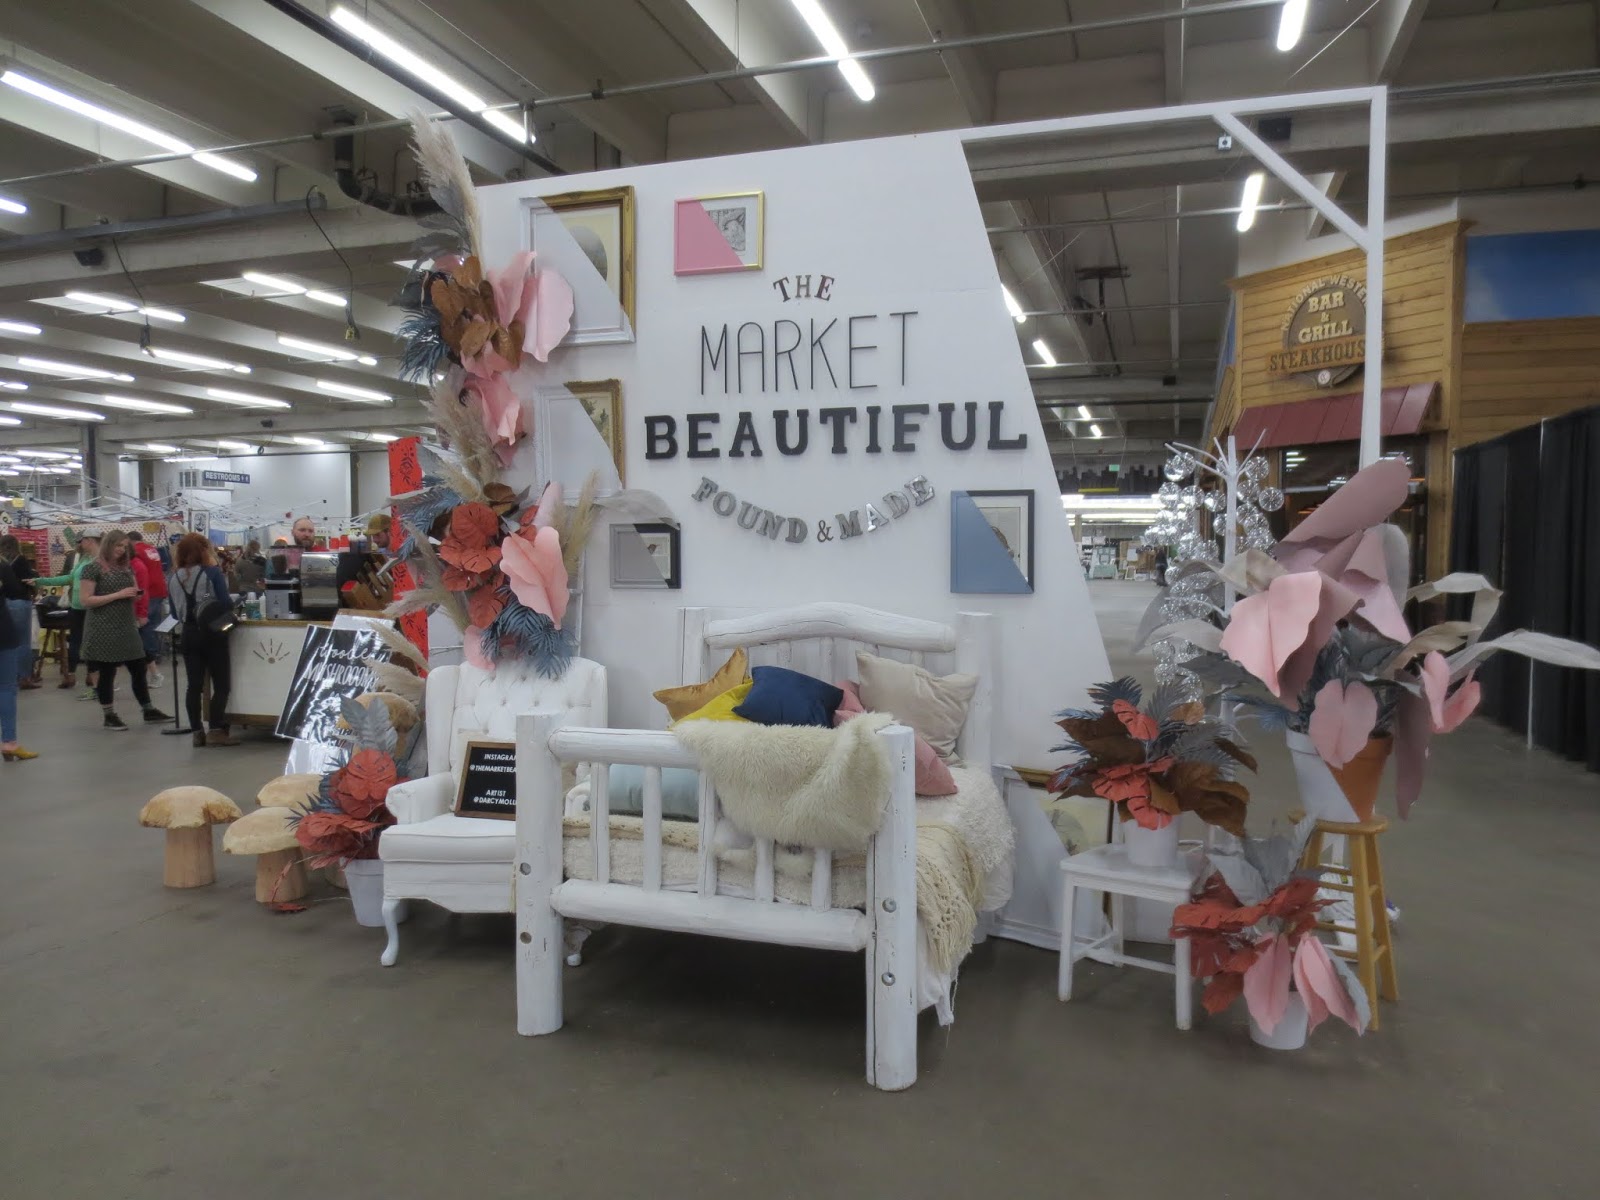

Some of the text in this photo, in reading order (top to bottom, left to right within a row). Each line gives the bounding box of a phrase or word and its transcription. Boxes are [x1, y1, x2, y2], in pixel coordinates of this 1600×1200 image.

[773, 274, 835, 302] THE
[1308, 291, 1345, 313] BAR
[1280, 278, 1326, 332] NATIONAL
[1320, 311, 1330, 323] &
[1298, 320, 1353, 344] GRILL
[701, 310, 919, 395] MARKET
[1269, 340, 1367, 372] STEAKHOUS
[644, 401, 1028, 460] BEAUTIFUL
[205, 471, 241, 482] RESTROOMS
[691, 474, 936, 544] FOUND & MADE
[486, 789, 507, 797] ARTIST
